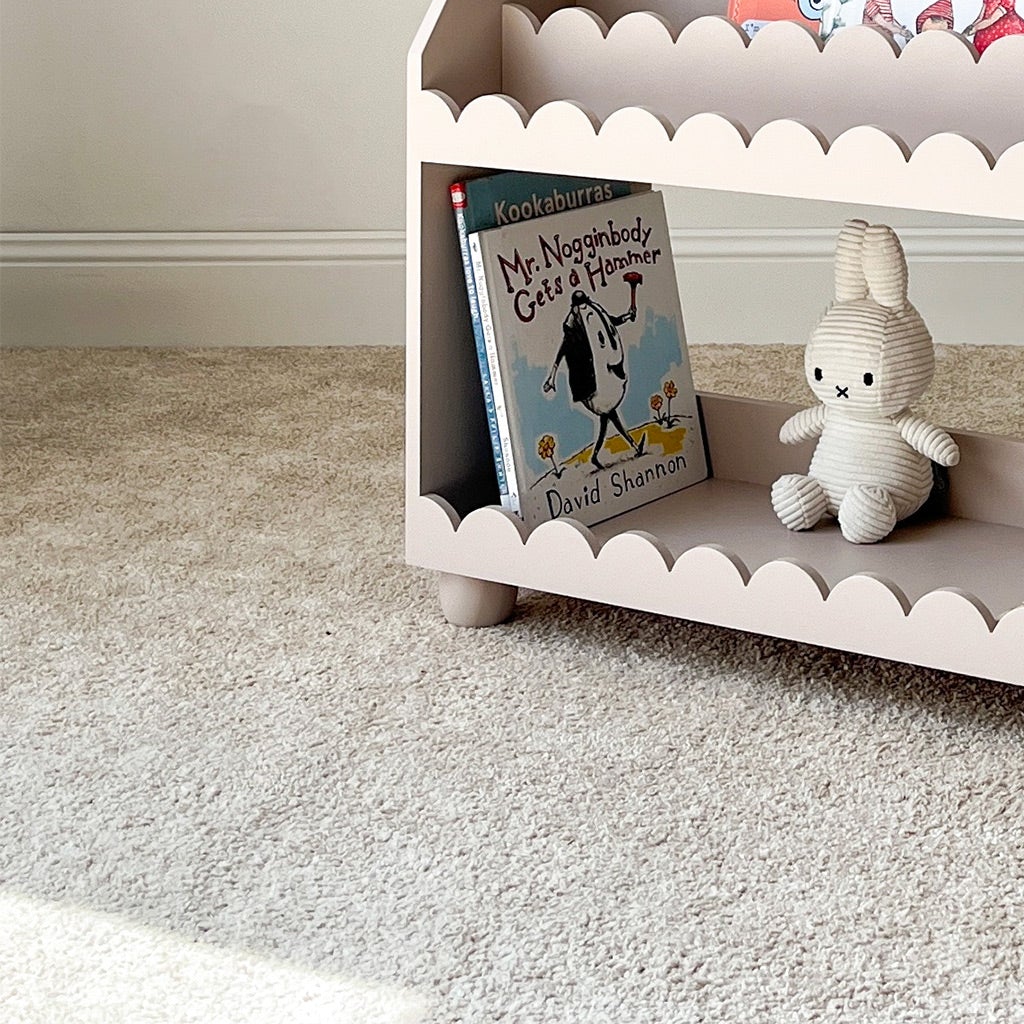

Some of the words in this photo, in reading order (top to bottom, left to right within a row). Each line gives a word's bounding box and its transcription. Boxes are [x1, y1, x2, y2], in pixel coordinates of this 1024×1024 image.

[494, 183, 613, 225] Kookaburras
[497, 247, 540, 294] Mr.
[538, 216, 652, 269] Nogginbody
[513, 275, 564, 323] Gets
[568, 268, 581, 288] a
[583, 248, 661, 293] Hammer
[545, 478, 601, 520] David
[610, 455, 687, 498] Shannon
